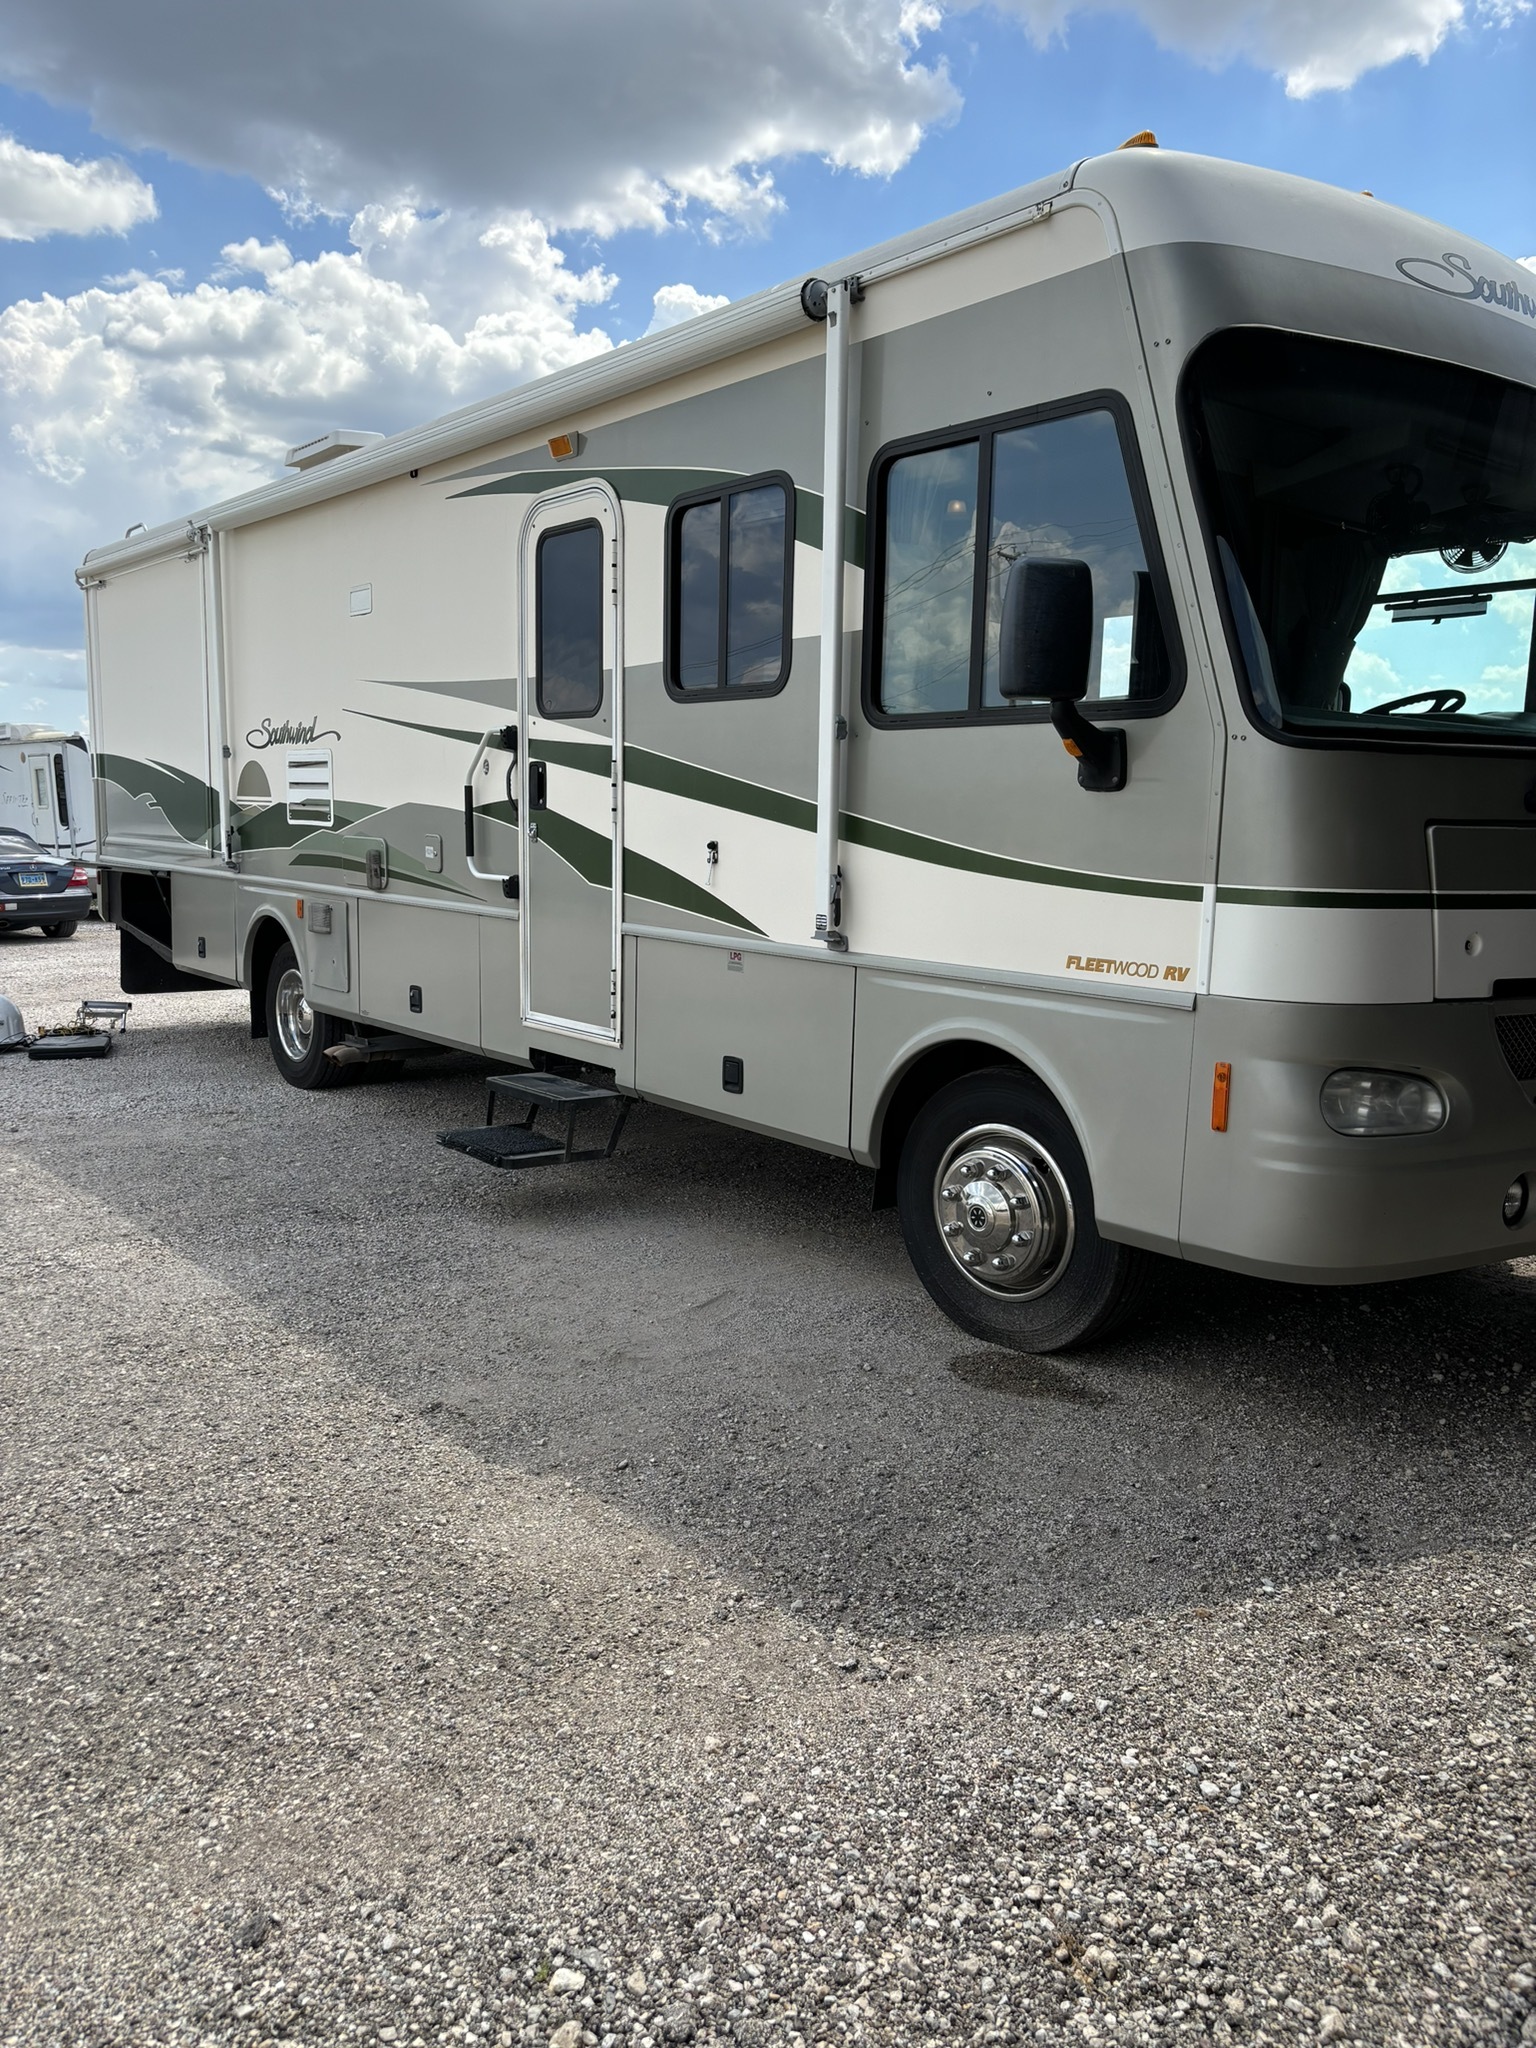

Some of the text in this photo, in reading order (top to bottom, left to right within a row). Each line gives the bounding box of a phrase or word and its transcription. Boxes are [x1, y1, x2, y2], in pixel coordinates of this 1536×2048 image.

[245, 715, 342, 749] Southwind
[729, 951, 742, 961] LPG
[1065, 955, 1191, 982] FLEETWOOD RV
